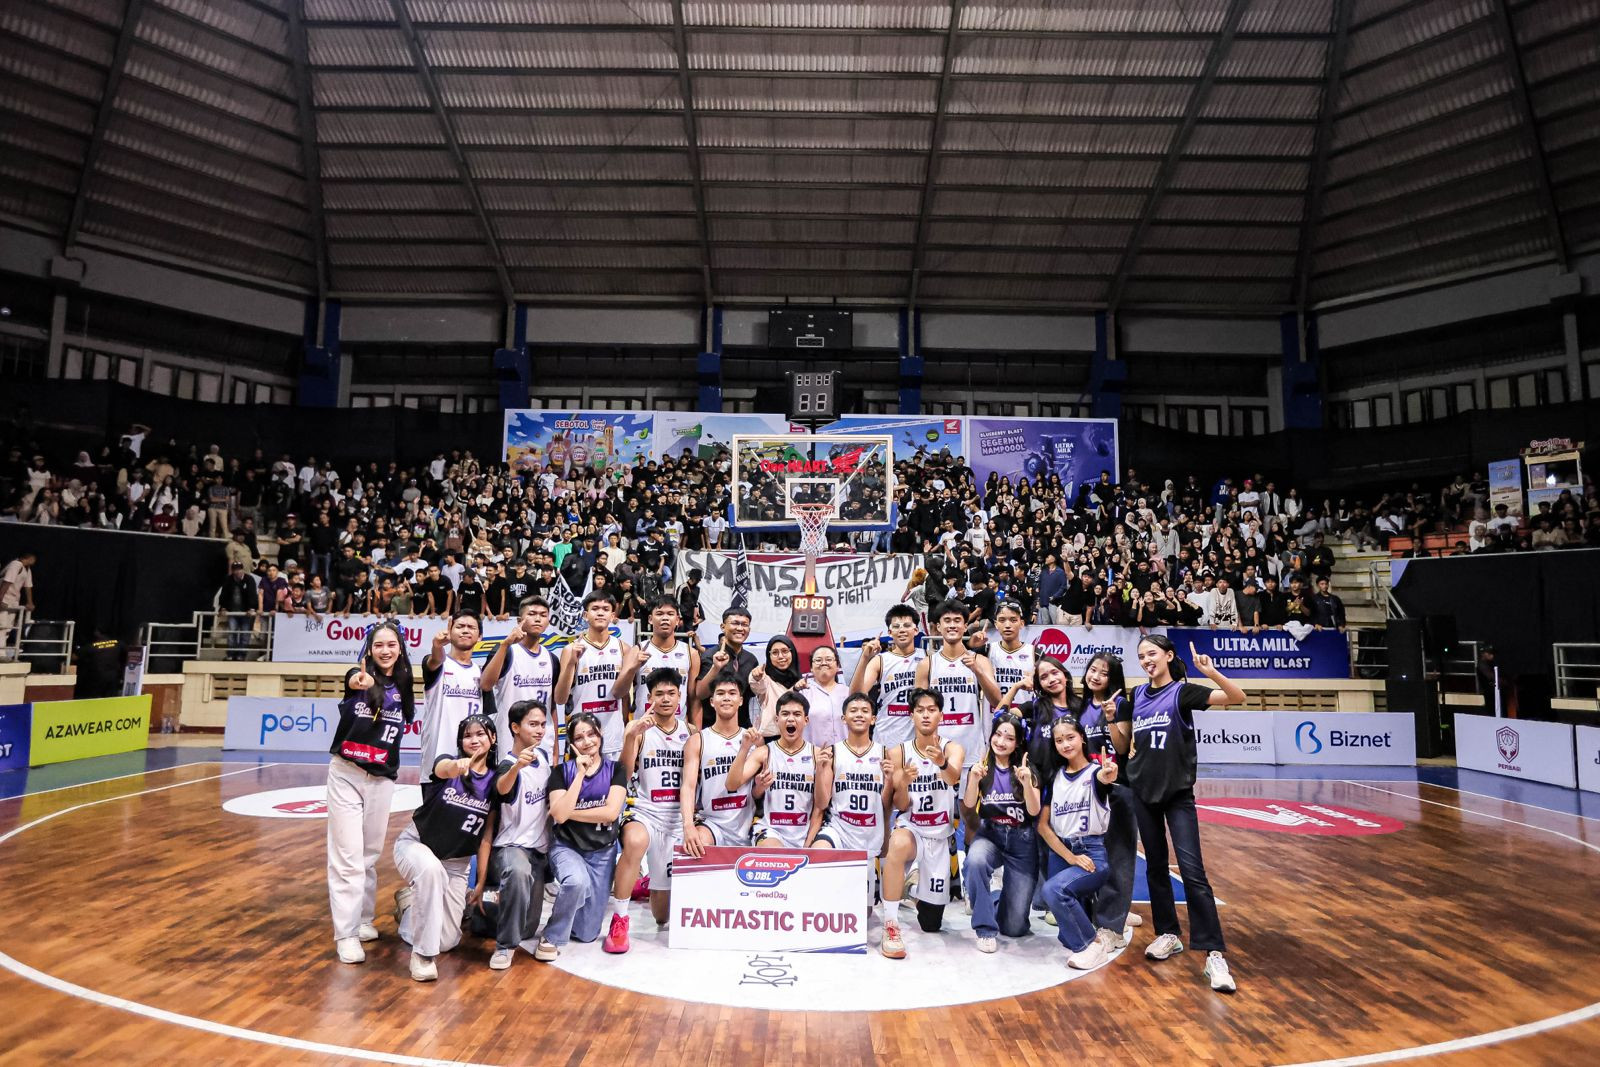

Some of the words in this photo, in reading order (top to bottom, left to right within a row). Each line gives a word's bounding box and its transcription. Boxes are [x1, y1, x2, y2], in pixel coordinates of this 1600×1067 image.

[555, 420, 589, 429] SEBOTOL
[981, 435, 1025, 448] SEGERNYA
[761, 459, 784, 473] One
[838, 587, 873, 606] FIGHT
[1213, 638, 1260, 651] ULTRA
[1262, 638, 1300, 651] MILK
[995, 667, 1023, 676] SMANSA
[1213, 657, 1270, 669] LUEBERRY
[1274, 658, 1311, 669] BLAST
[938, 676, 967, 686] SMANSA
[597, 684, 606, 699] 0
[949, 696, 956, 712] 1
[260, 704, 327, 745] posh
[1132, 711, 1171, 732] aleendah
[380, 724, 399, 744] 12
[1150, 730, 1167, 749] 17
[1195, 728, 1262, 745] Jackson
[1330, 730, 1391, 748] Biznet
[661, 771, 680, 788] 29
[776, 771, 806, 783] SMANSA
[845, 772, 875, 783] SMANSA
[784, 794, 795, 811] 5
[849, 794, 868, 811] 90
[918, 794, 934, 812] 12
[461, 813, 485, 837] 27
[1079, 815, 1089, 833] 3
[754, 871, 772, 881] DBL
[929, 877, 945, 893] 12
[681, 907, 795, 932] FANTASTIC
[802, 911, 859, 934] FOUR
